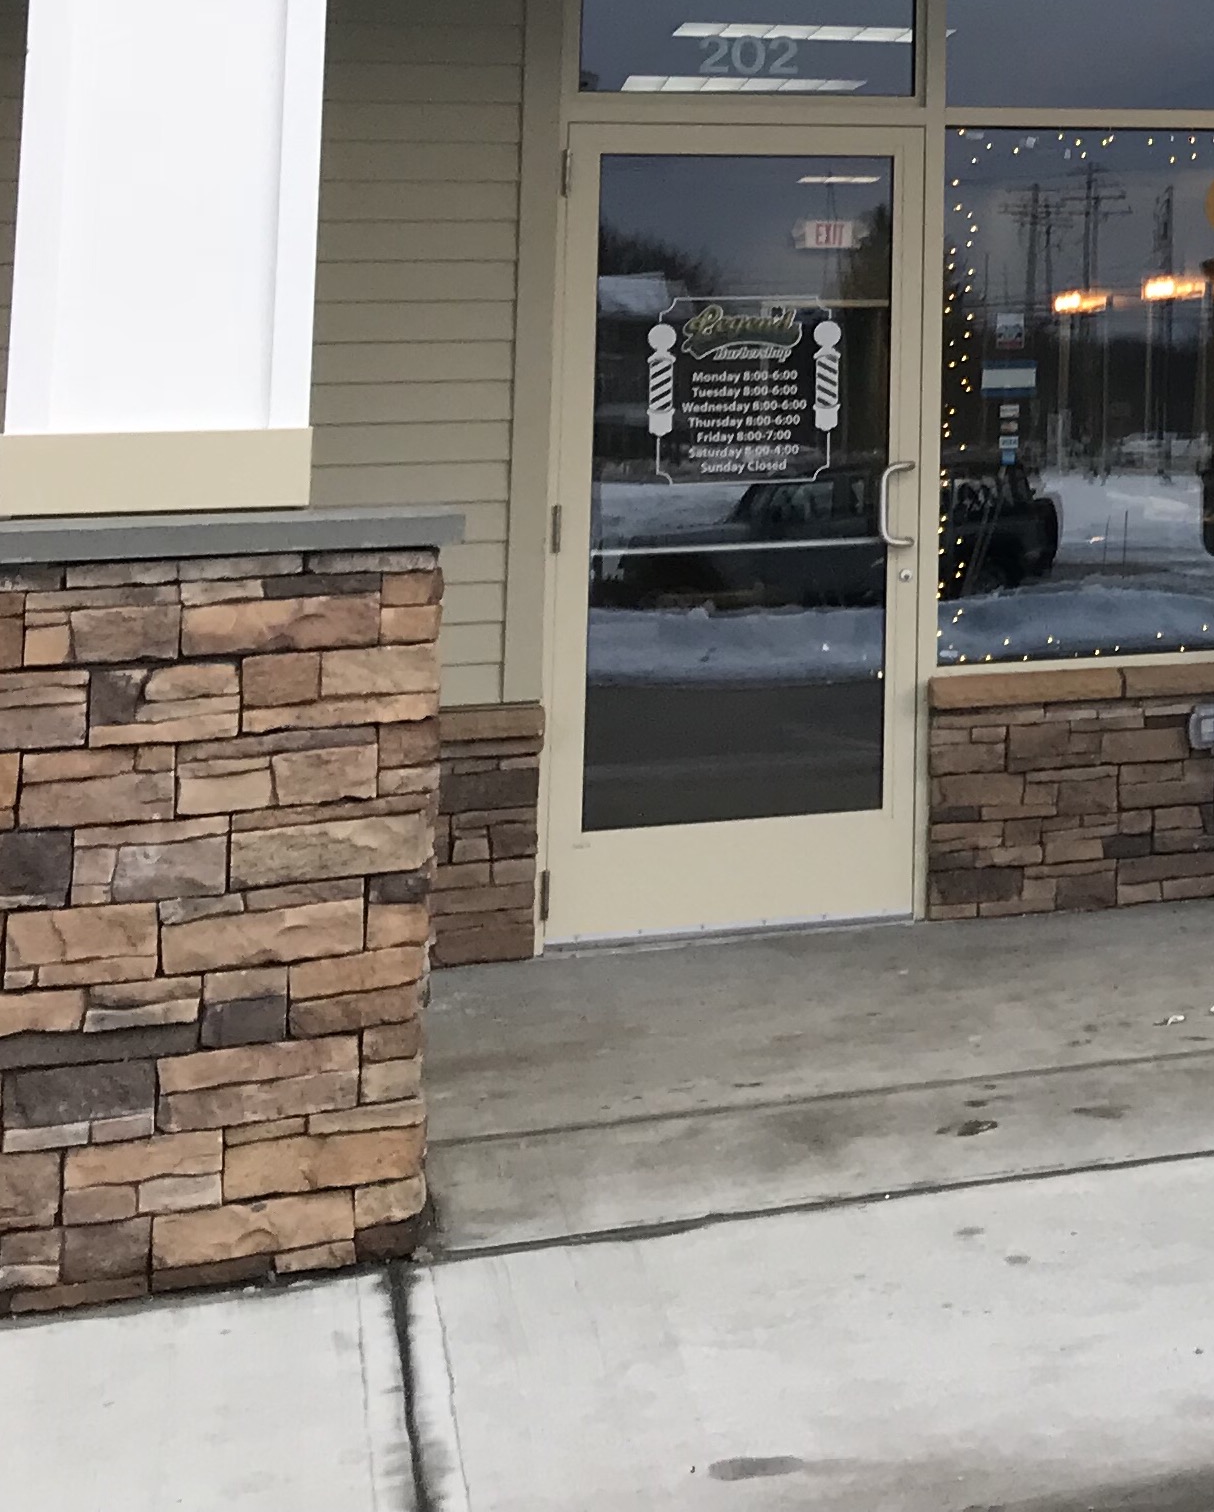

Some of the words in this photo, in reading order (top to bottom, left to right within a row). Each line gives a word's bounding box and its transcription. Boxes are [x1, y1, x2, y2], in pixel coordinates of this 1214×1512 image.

[699, 35, 799, 75] 202
[815, 223, 844, 245] EXIT
[692, 371, 741, 384] Monday
[692, 386, 741, 399] Tuesday
[682, 400, 751, 414] Wednesday
[687, 416, 743, 429] Thursday
[696, 431, 735, 444] Friday
[688, 445, 742, 459] Saturday
[701, 460, 745, 474] Sunday
[747, 458, 787, 472] Closed
